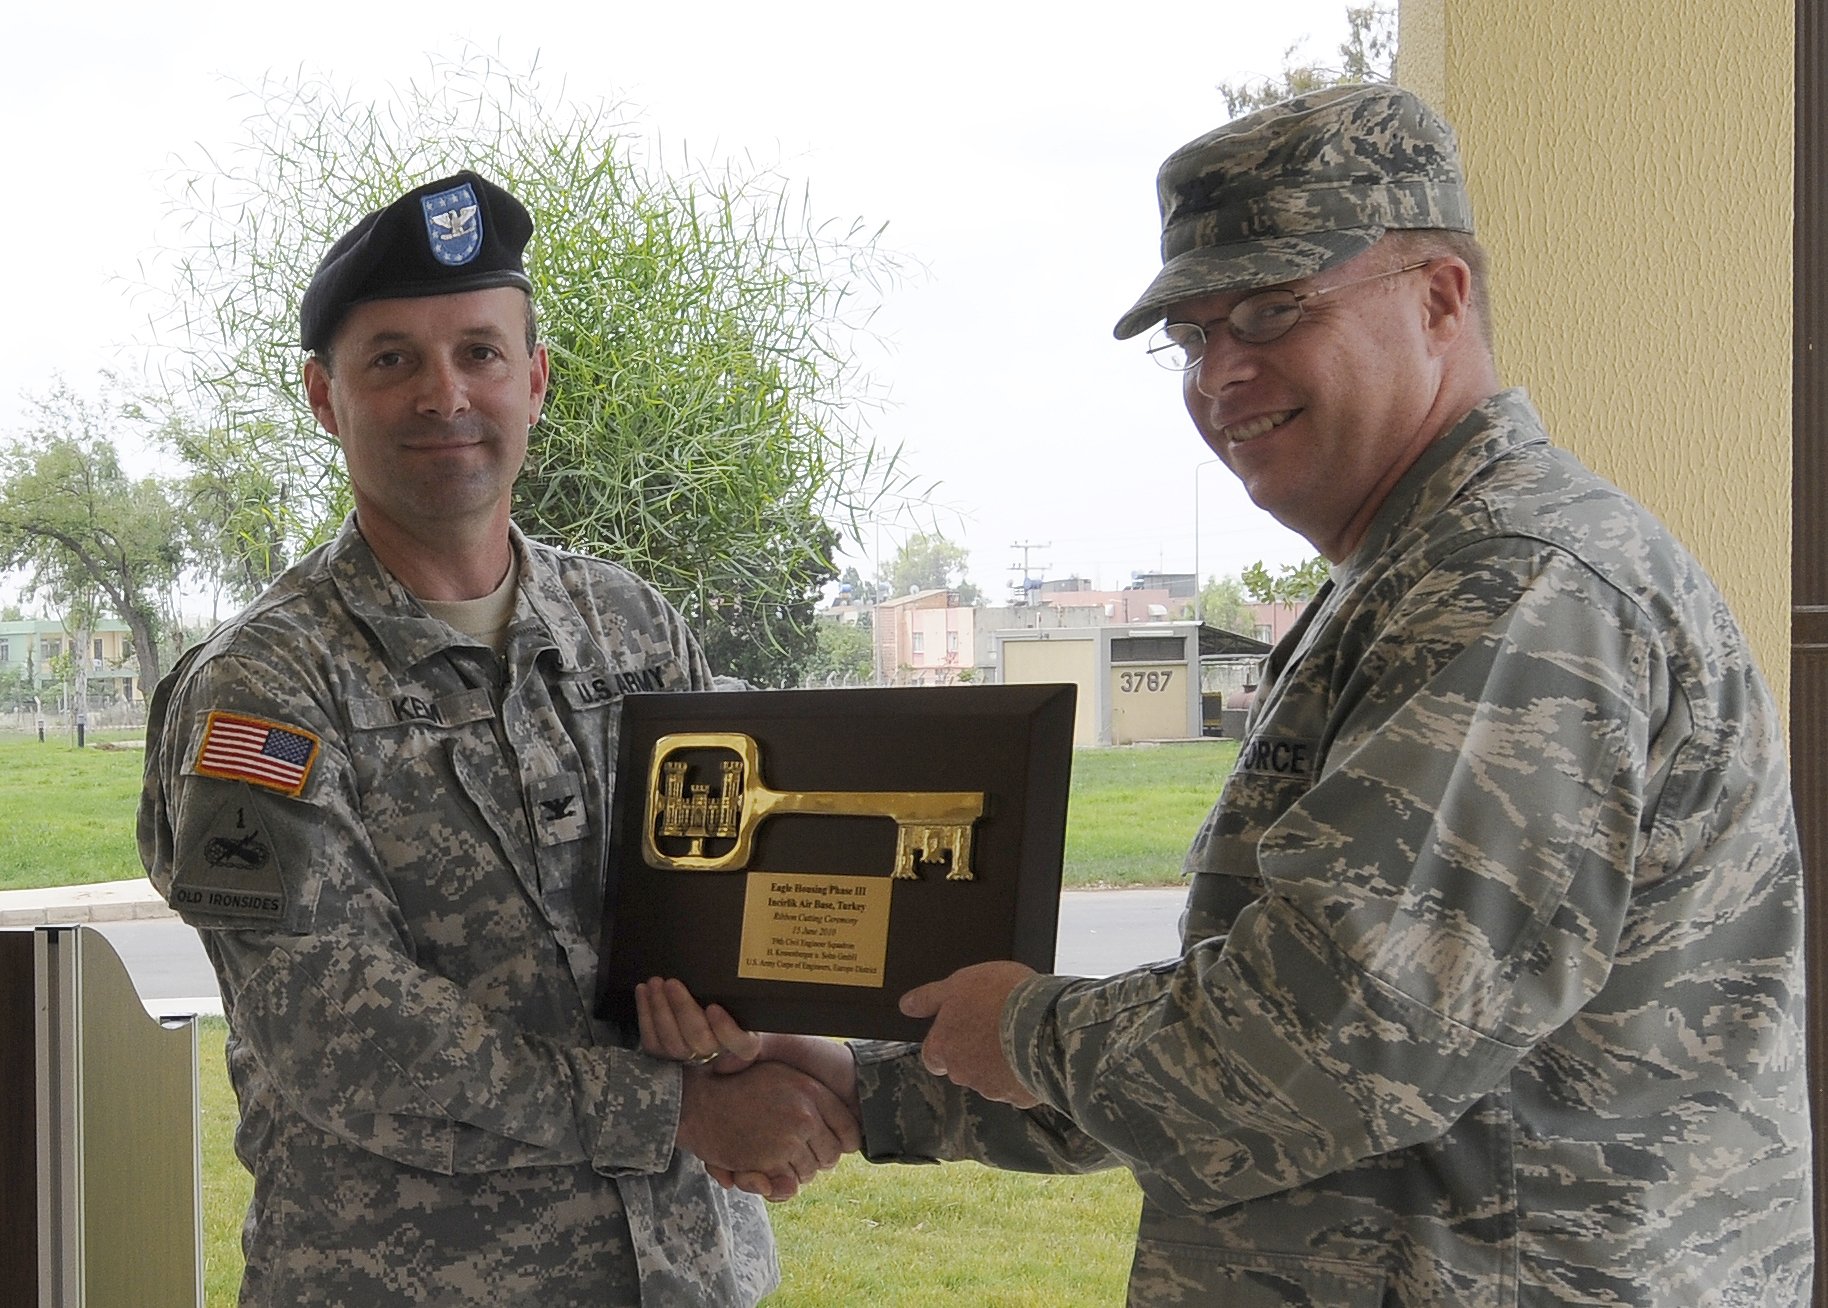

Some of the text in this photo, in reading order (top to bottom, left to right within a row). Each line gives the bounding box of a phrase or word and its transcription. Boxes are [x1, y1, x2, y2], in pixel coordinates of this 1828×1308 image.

[576, 666, 665, 703] U.S. ARMY
[1120, 670, 1173, 693] 3787
[1243, 740, 1307, 773] ORCE
[236, 807, 245, 829] 1
[771, 883, 866, 896] Eagle Housing Phase III
[177, 890, 279, 911] OLD IRONSIDES
[799, 899, 812, 908] Air
[814, 899, 835, 910] Base,
[837, 900, 867, 913] Turkey
[773, 912, 858, 926] Ribbon Cutting Ceremony
